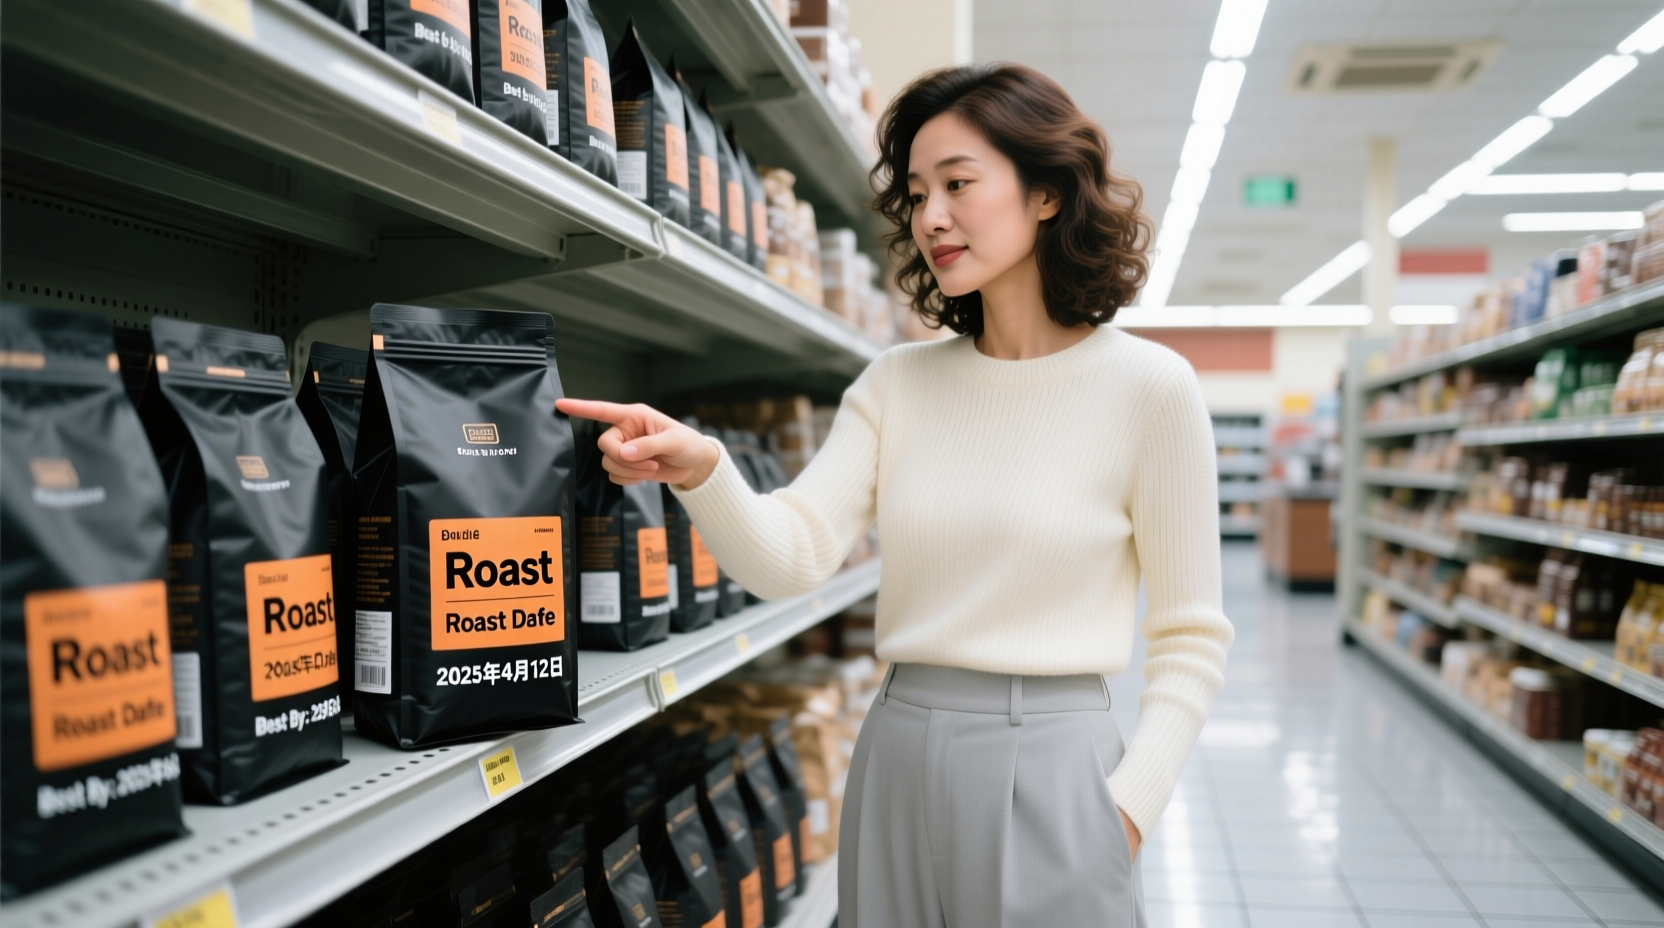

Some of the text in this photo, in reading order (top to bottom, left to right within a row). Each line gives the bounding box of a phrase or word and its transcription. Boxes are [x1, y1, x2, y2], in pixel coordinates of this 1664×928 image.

[445, 551, 553, 589] Roast
[263, 592, 335, 635] Roast
[446, 611, 506, 633] Roast
[51, 632, 161, 686] Roast
[436, 656, 563, 686] 2025年4月12日
